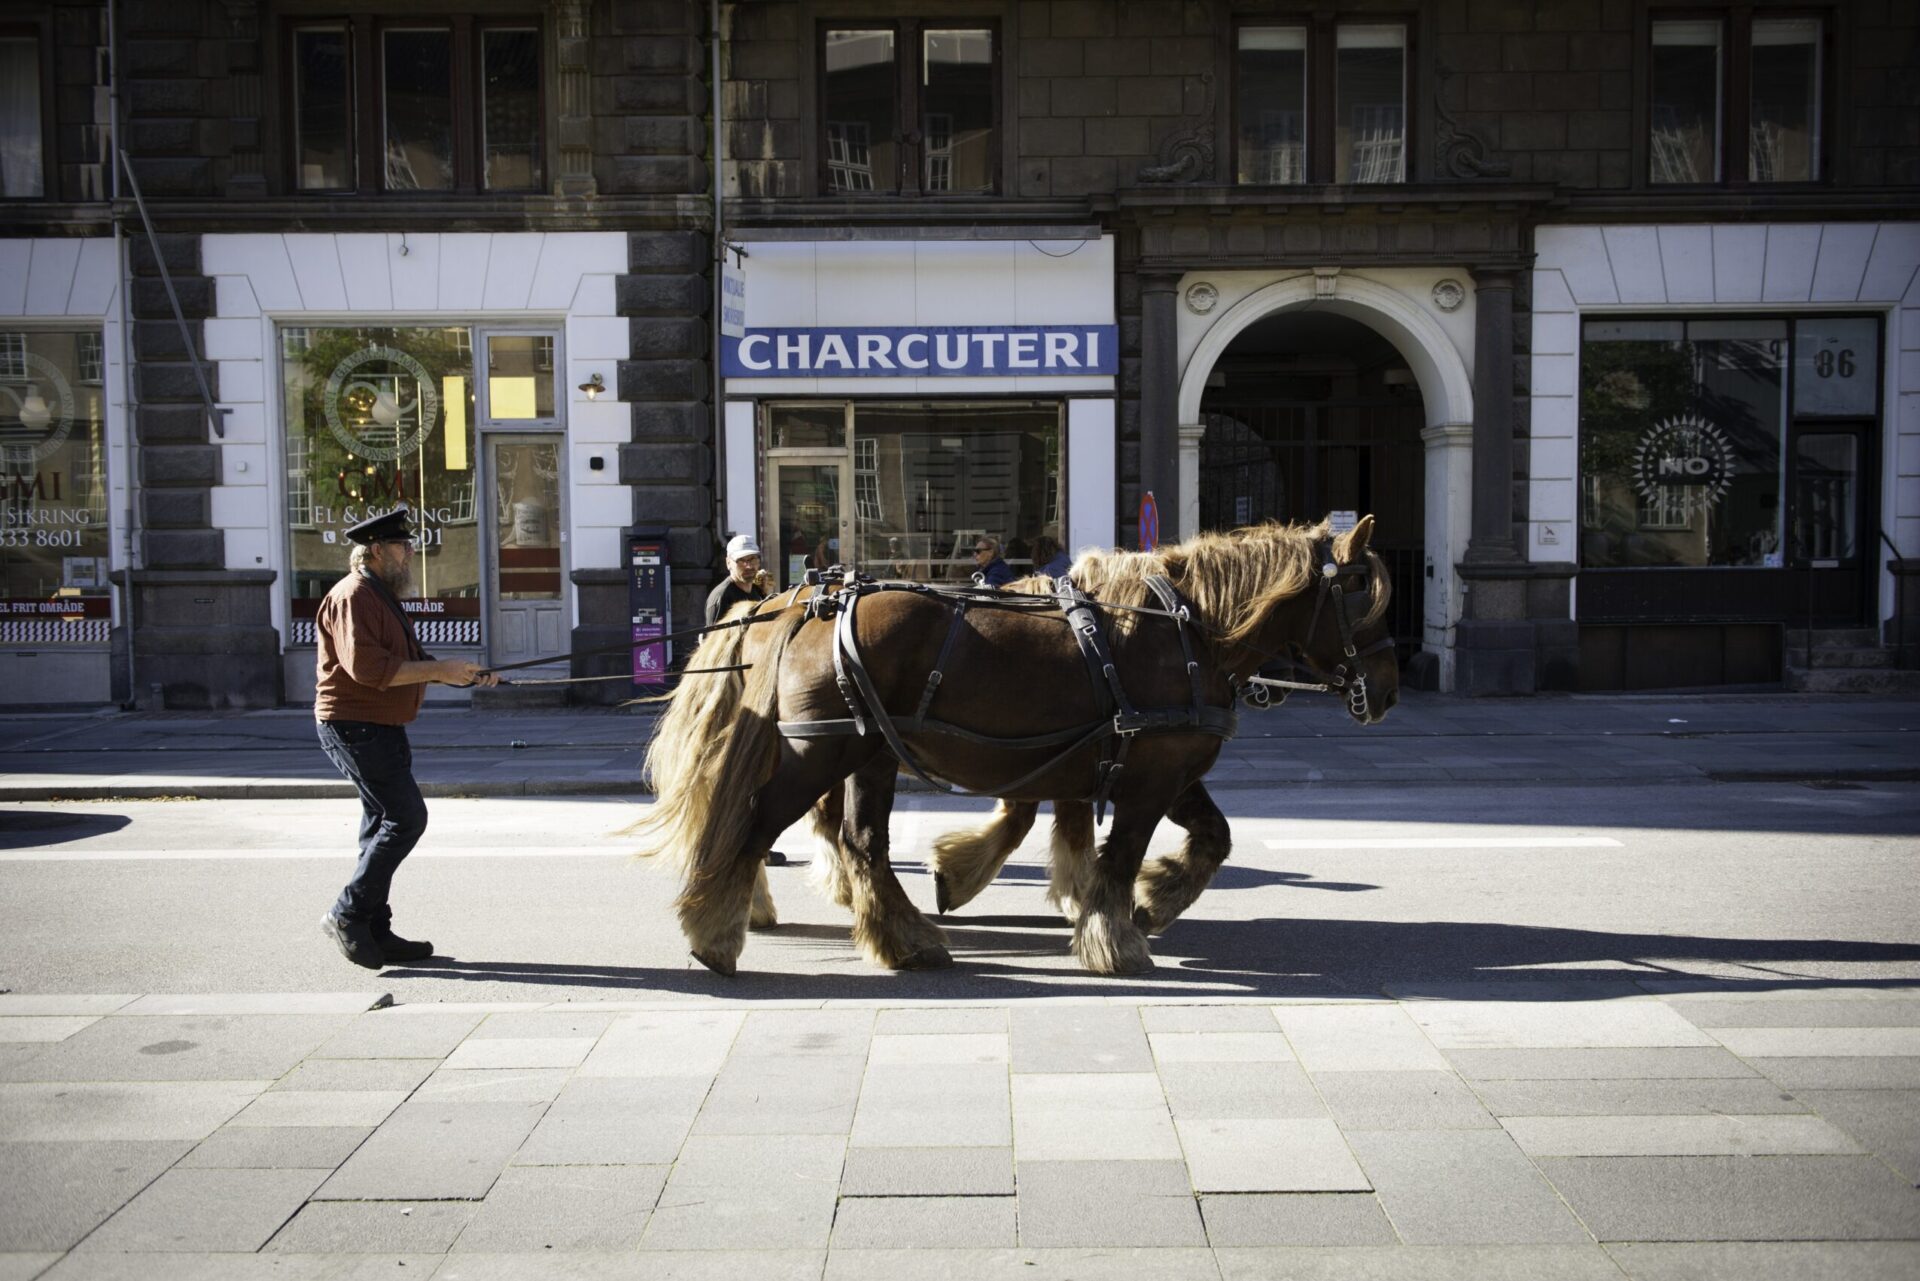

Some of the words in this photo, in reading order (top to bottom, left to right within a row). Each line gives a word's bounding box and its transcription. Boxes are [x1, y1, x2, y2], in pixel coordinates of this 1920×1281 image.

[738, 332, 1100, 371] CHARCUTERI
[1815, 348, 1855, 378] 86
[1658, 457, 1710, 475] NO
[338, 469, 422, 499] GMI
[7, 506, 90, 525] SIKRING
[315, 506, 336, 523] EL
[343, 506, 361, 524] &
[36, 529, 83, 547] 8601
[408, 528, 443, 546] 601
[12, 602, 37, 613] FRIT
[39, 598, 85, 613] OMRÅDE
